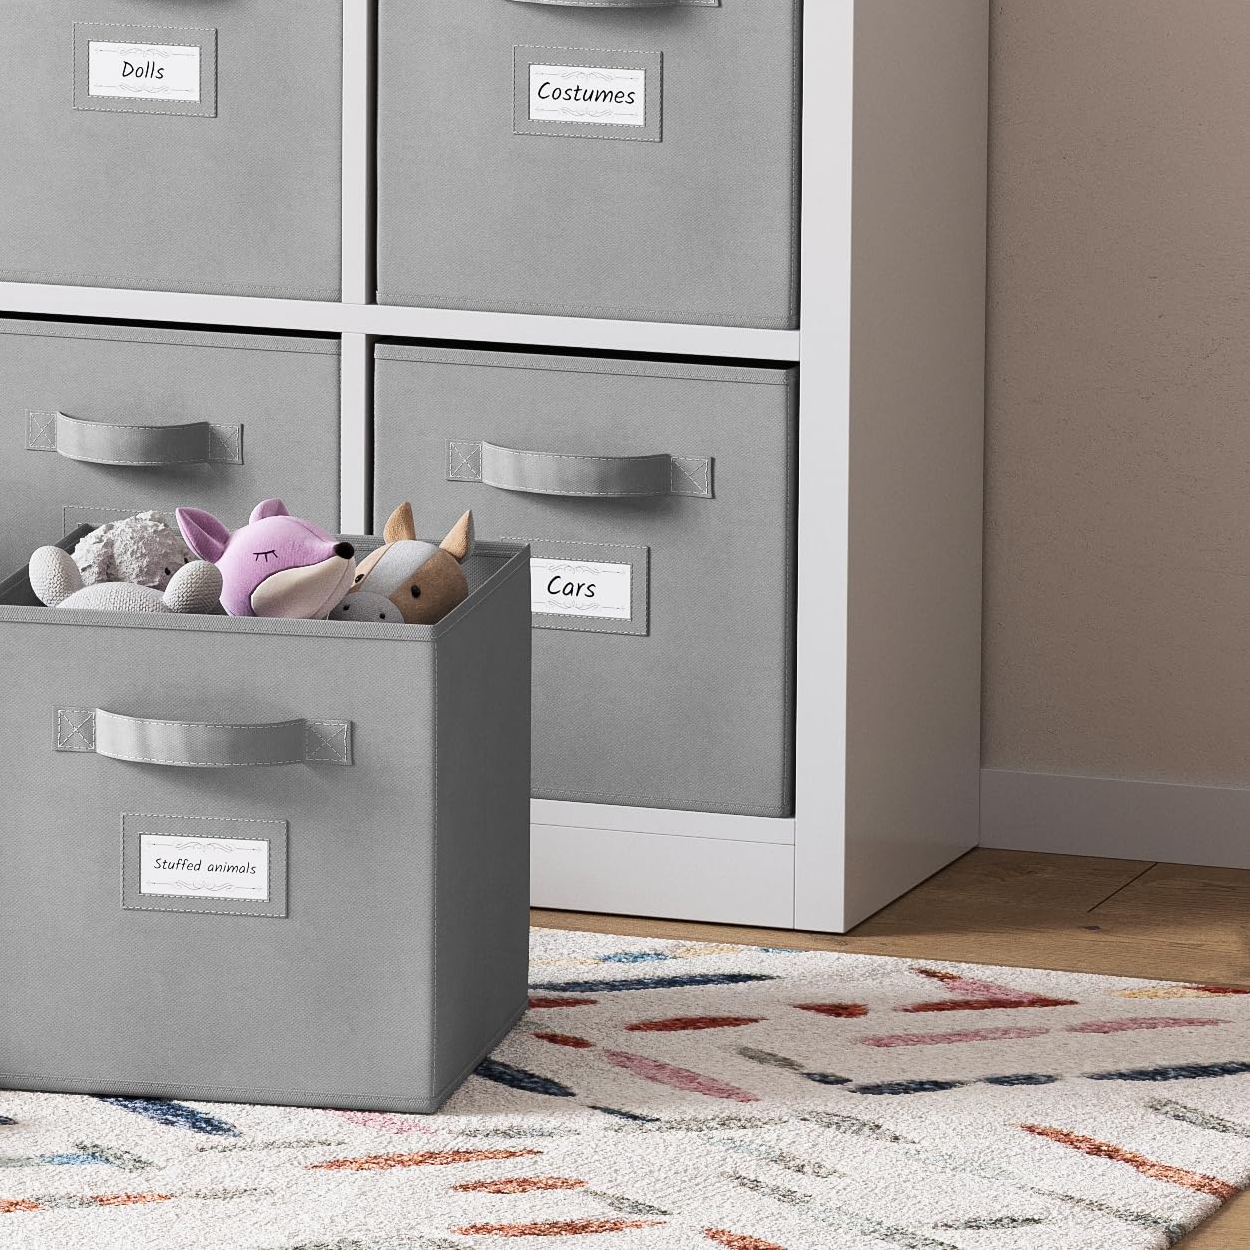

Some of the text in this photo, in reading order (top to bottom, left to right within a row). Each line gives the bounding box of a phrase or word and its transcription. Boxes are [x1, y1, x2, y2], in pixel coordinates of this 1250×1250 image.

[121, 60, 165, 80] Dolls
[537, 81, 636, 105] Costumes
[547, 575, 597, 598] Cars
[153, 857, 258, 875] Stuffed animals
